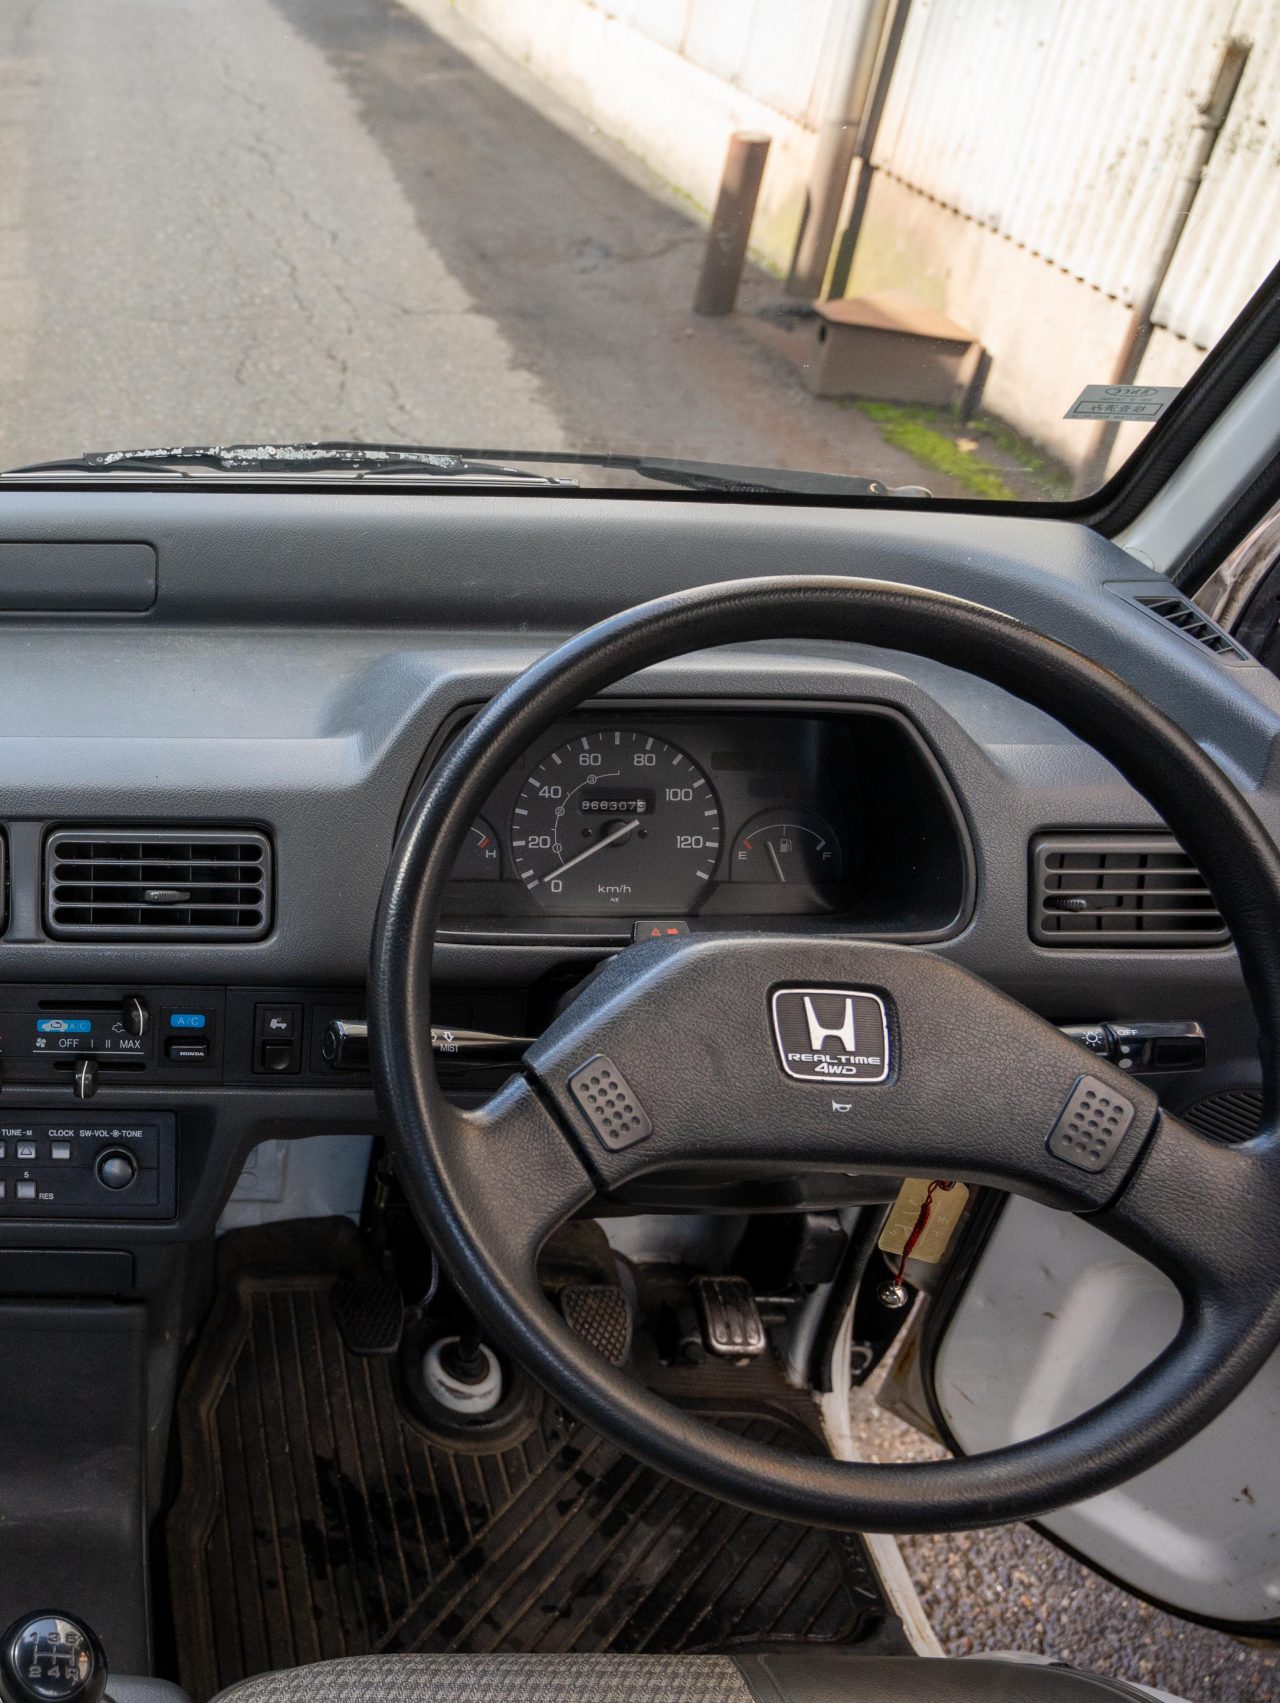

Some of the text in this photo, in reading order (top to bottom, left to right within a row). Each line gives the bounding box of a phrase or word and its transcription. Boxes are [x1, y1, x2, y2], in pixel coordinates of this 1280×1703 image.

[578, 753, 602, 766] 60
[633, 753, 656, 766] 80
[538, 785, 562, 799] 40
[665, 788, 693, 802] 100
[528, 835, 550, 849] 20
[676, 835, 703, 849] 120
[485, 850, 496, 858] H
[738, 851, 748, 860] E
[822, 851, 832, 860] F
[550, 879, 563, 893] 0
[598, 884, 631, 893] km/h
[69, 1022, 87, 1030] A/C
[177, 1017, 199, 1026] A/C
[58, 1038, 80, 1048] OFF
[119, 1040, 141, 1049] MAX
[440, 1044, 459, 1053] MIST
[814, 1063, 857, 1074] 4WD
[48, 1129, 75, 1137] CLOCK
[30, 1631, 39, 1644] 1
[47, 1631, 60, 1645] 3
[29, 1665, 42, 1678] 2
[47, 1665, 60, 1678] 4
